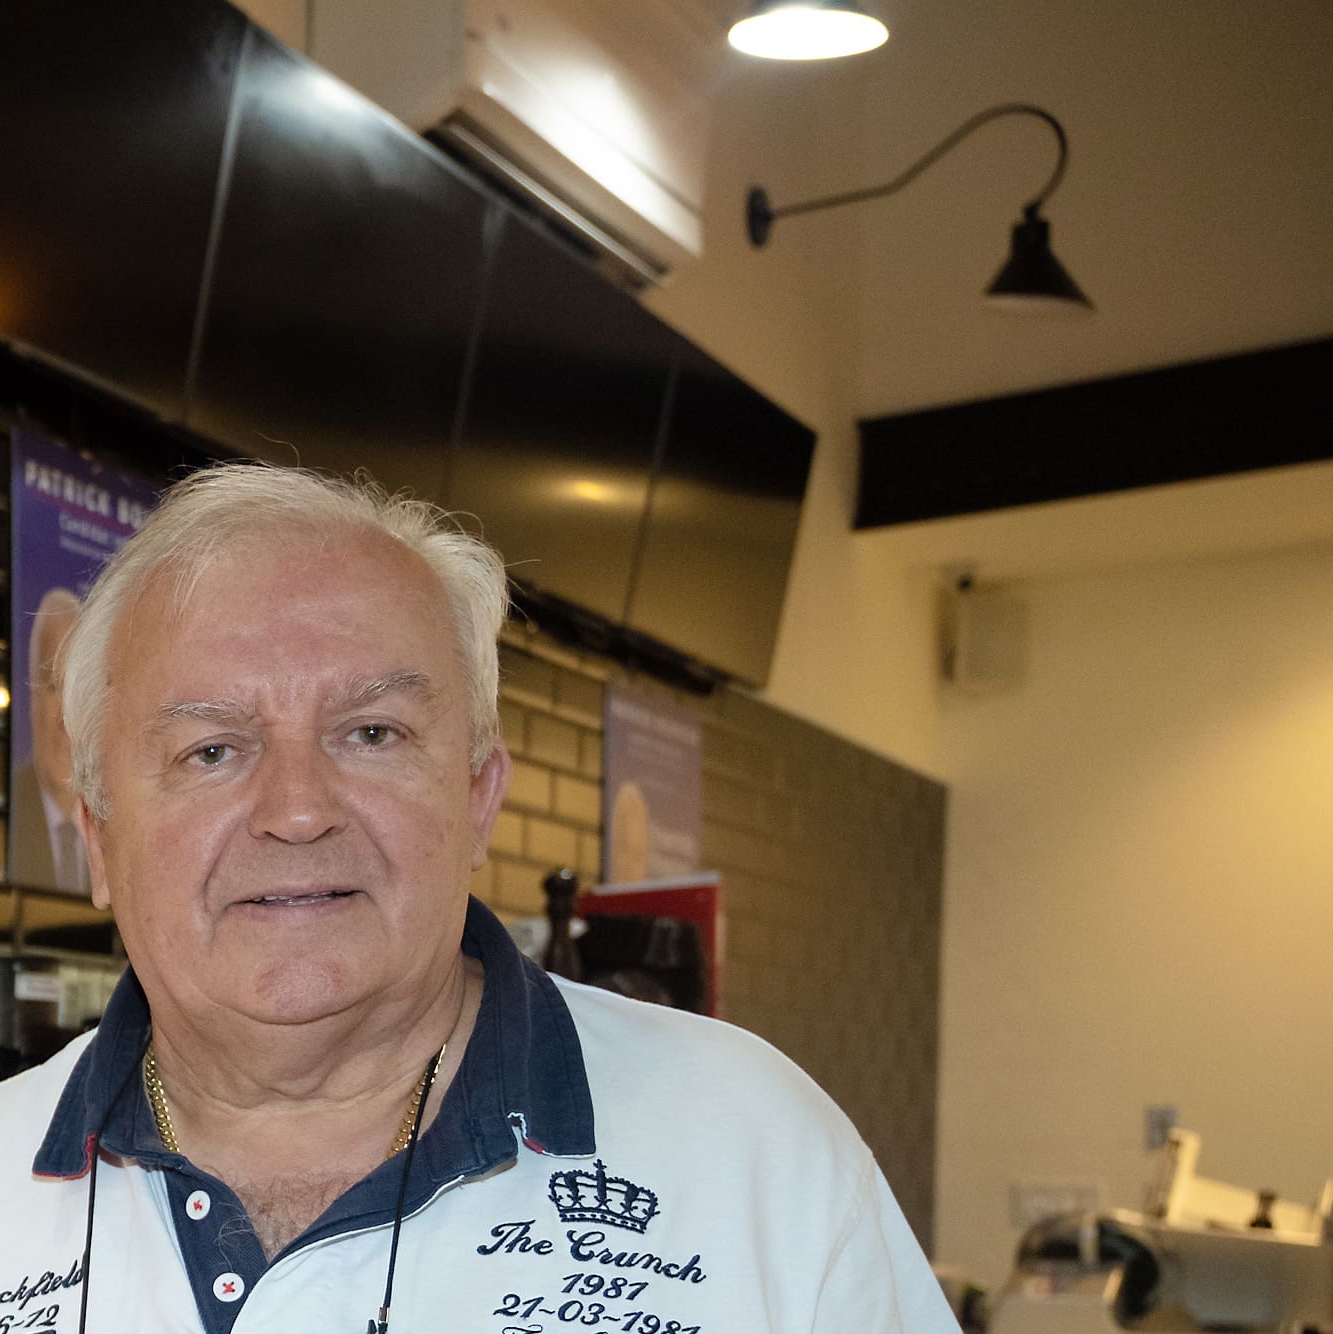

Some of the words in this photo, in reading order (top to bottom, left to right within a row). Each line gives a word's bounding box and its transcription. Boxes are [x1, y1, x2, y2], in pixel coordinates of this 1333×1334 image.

[477, 1220, 554, 1255] The
[566, 1230, 707, 1284] Crunch
[561, 1273, 649, 1301] 1981
